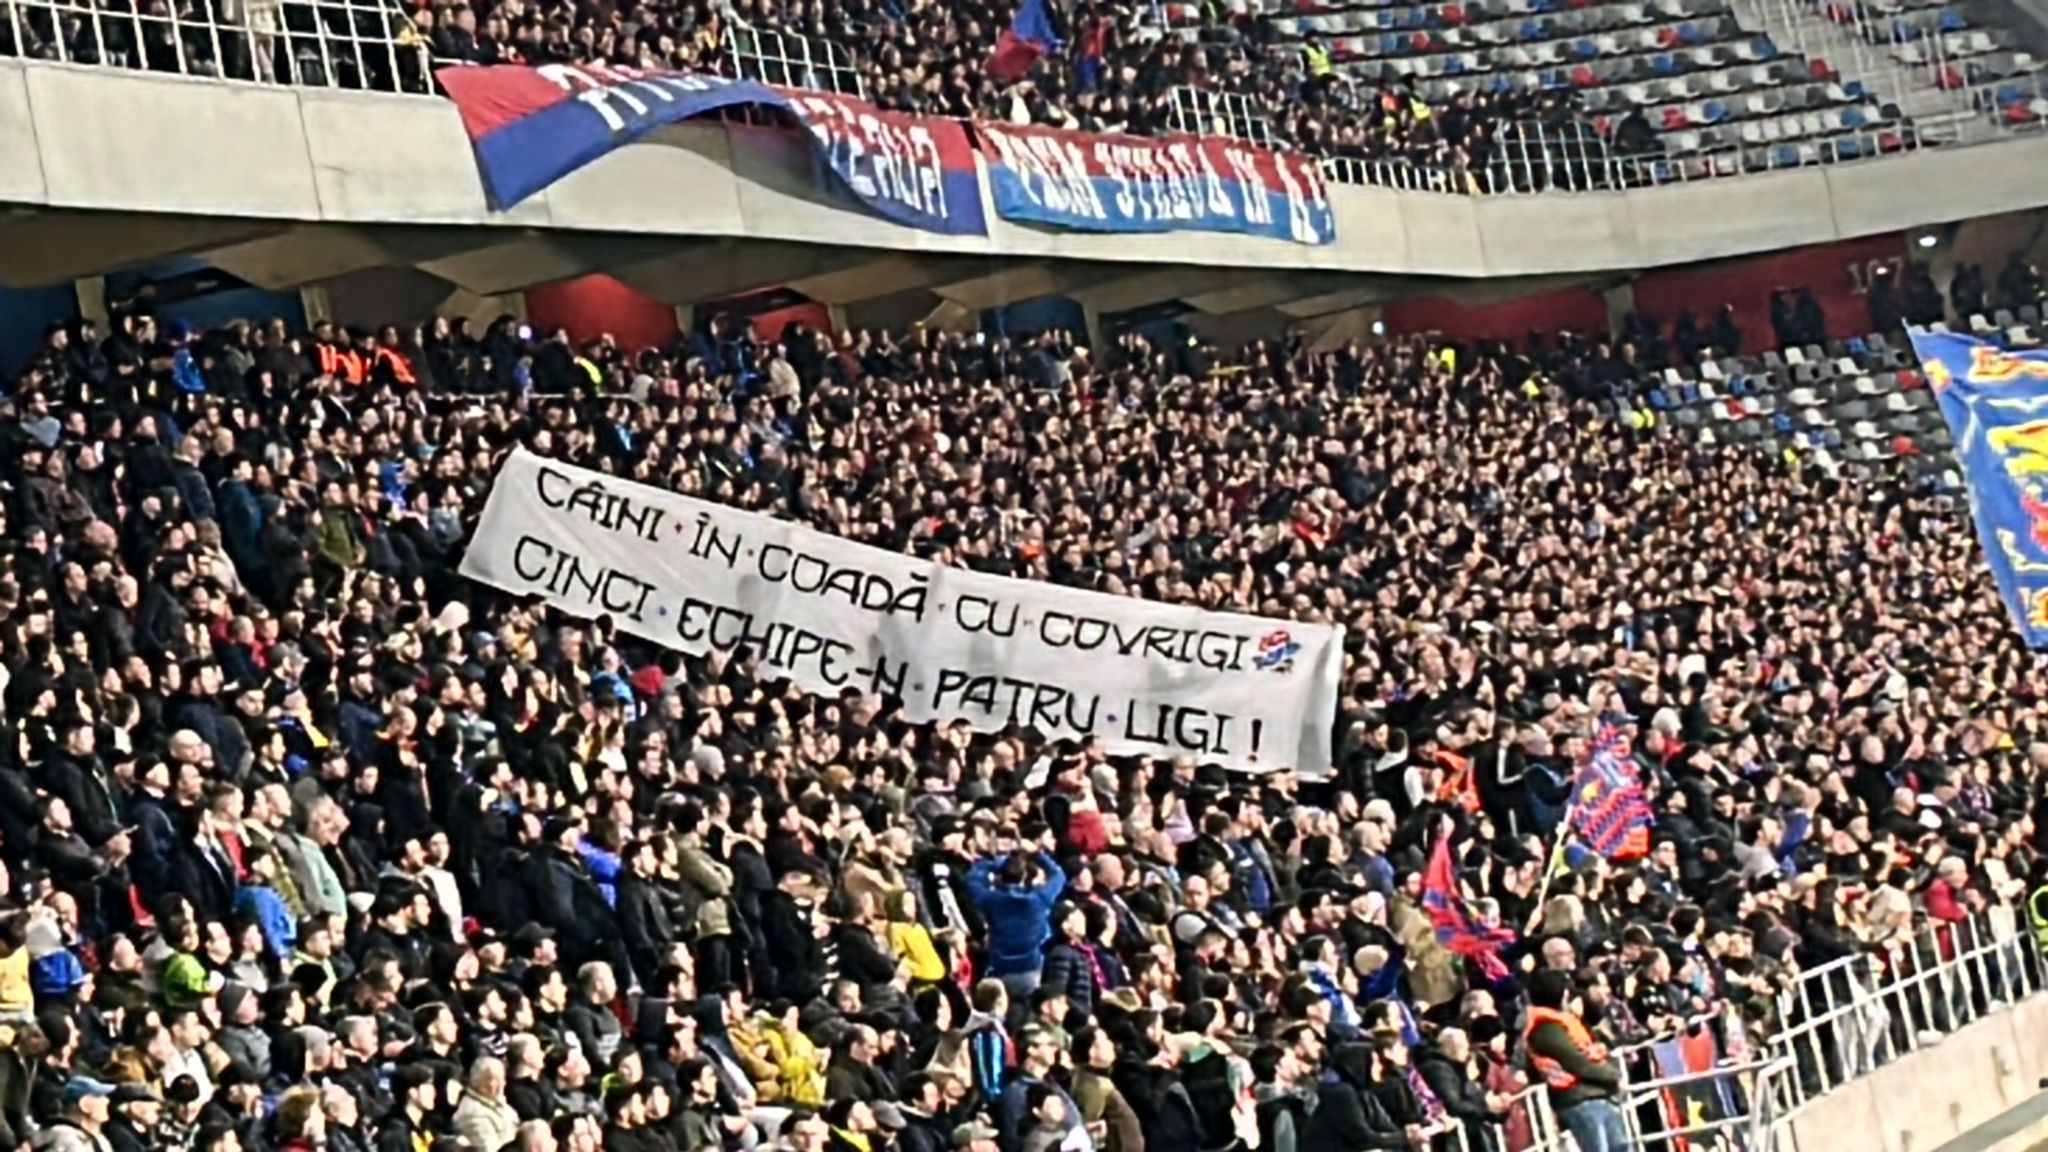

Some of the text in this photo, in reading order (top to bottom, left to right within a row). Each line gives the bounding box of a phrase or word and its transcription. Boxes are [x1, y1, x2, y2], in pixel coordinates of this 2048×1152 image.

[513, 535, 657, 622] CINCI
[932, 668, 1099, 734] PATRU
[537, 466, 1251, 672] CÂINI ÎN COADĂ CU COVRIGI
